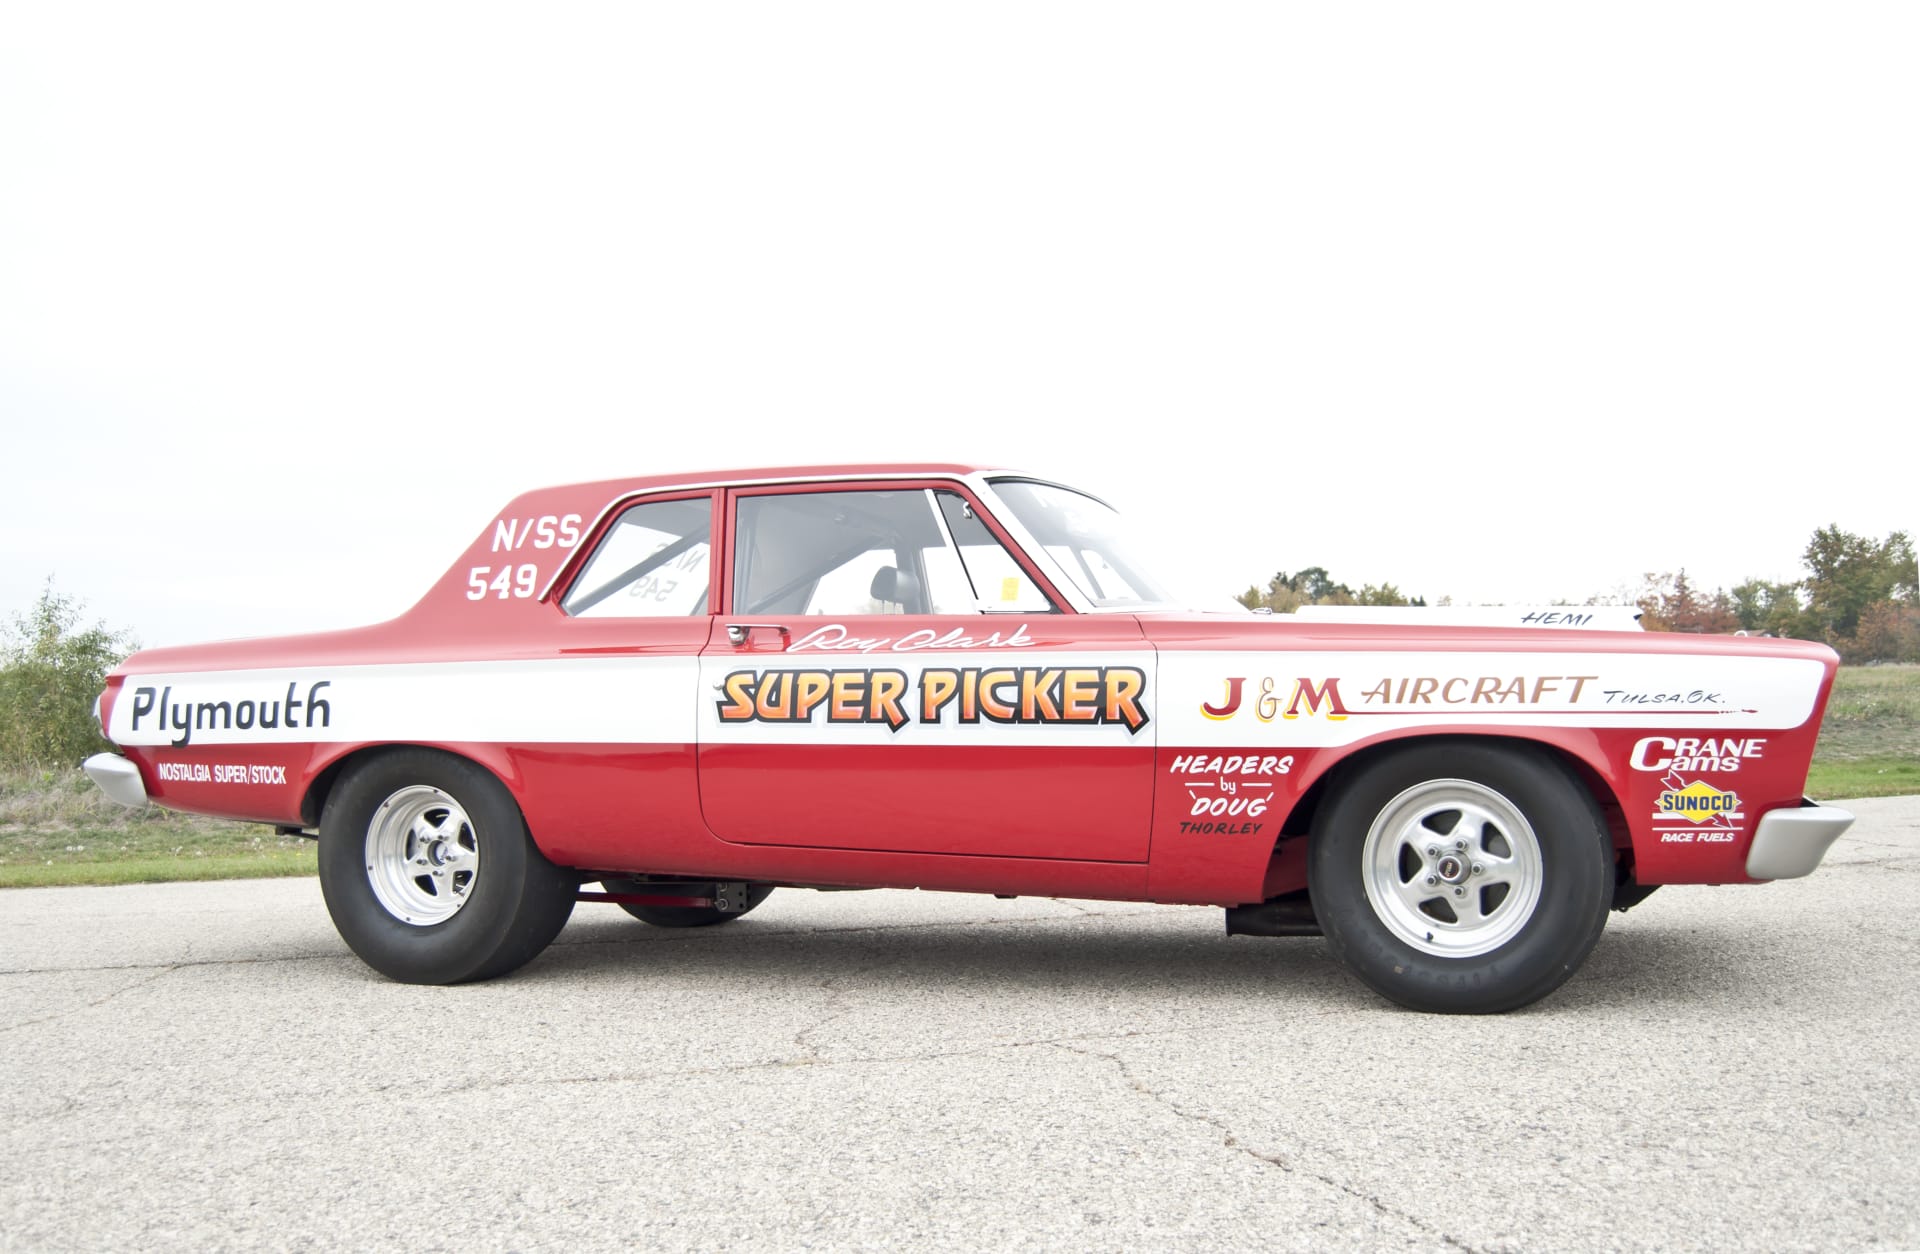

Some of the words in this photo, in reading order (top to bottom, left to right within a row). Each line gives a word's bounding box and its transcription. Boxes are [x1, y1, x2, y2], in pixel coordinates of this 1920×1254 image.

[491, 514, 582, 552] N/SS
[466, 564, 538, 600] 549
[1520, 611, 1593, 626] HEMI
[786, 624, 889, 652] Roy
[891, 624, 1036, 651] Clark
[718, 668, 910, 733] SUPER
[918, 666, 1150, 736] PICKER
[1361, 676, 1599, 704] AIRCRAFT
[131, 681, 331, 748] Plymouth
[1170, 755, 1294, 775] HEADERS
[1629, 736, 1767, 771] CRANE
[158, 763, 211, 782] NOSTALGIA
[214, 764, 287, 784] SUPER/STOCK
[1220, 777, 1236, 795] by
[1663, 793, 1733, 812] SUNOCO
[1179, 821, 1263, 835] THORLEY
[1661, 832, 1693, 842] RACE
[1697, 832, 1734, 842] FUELS
